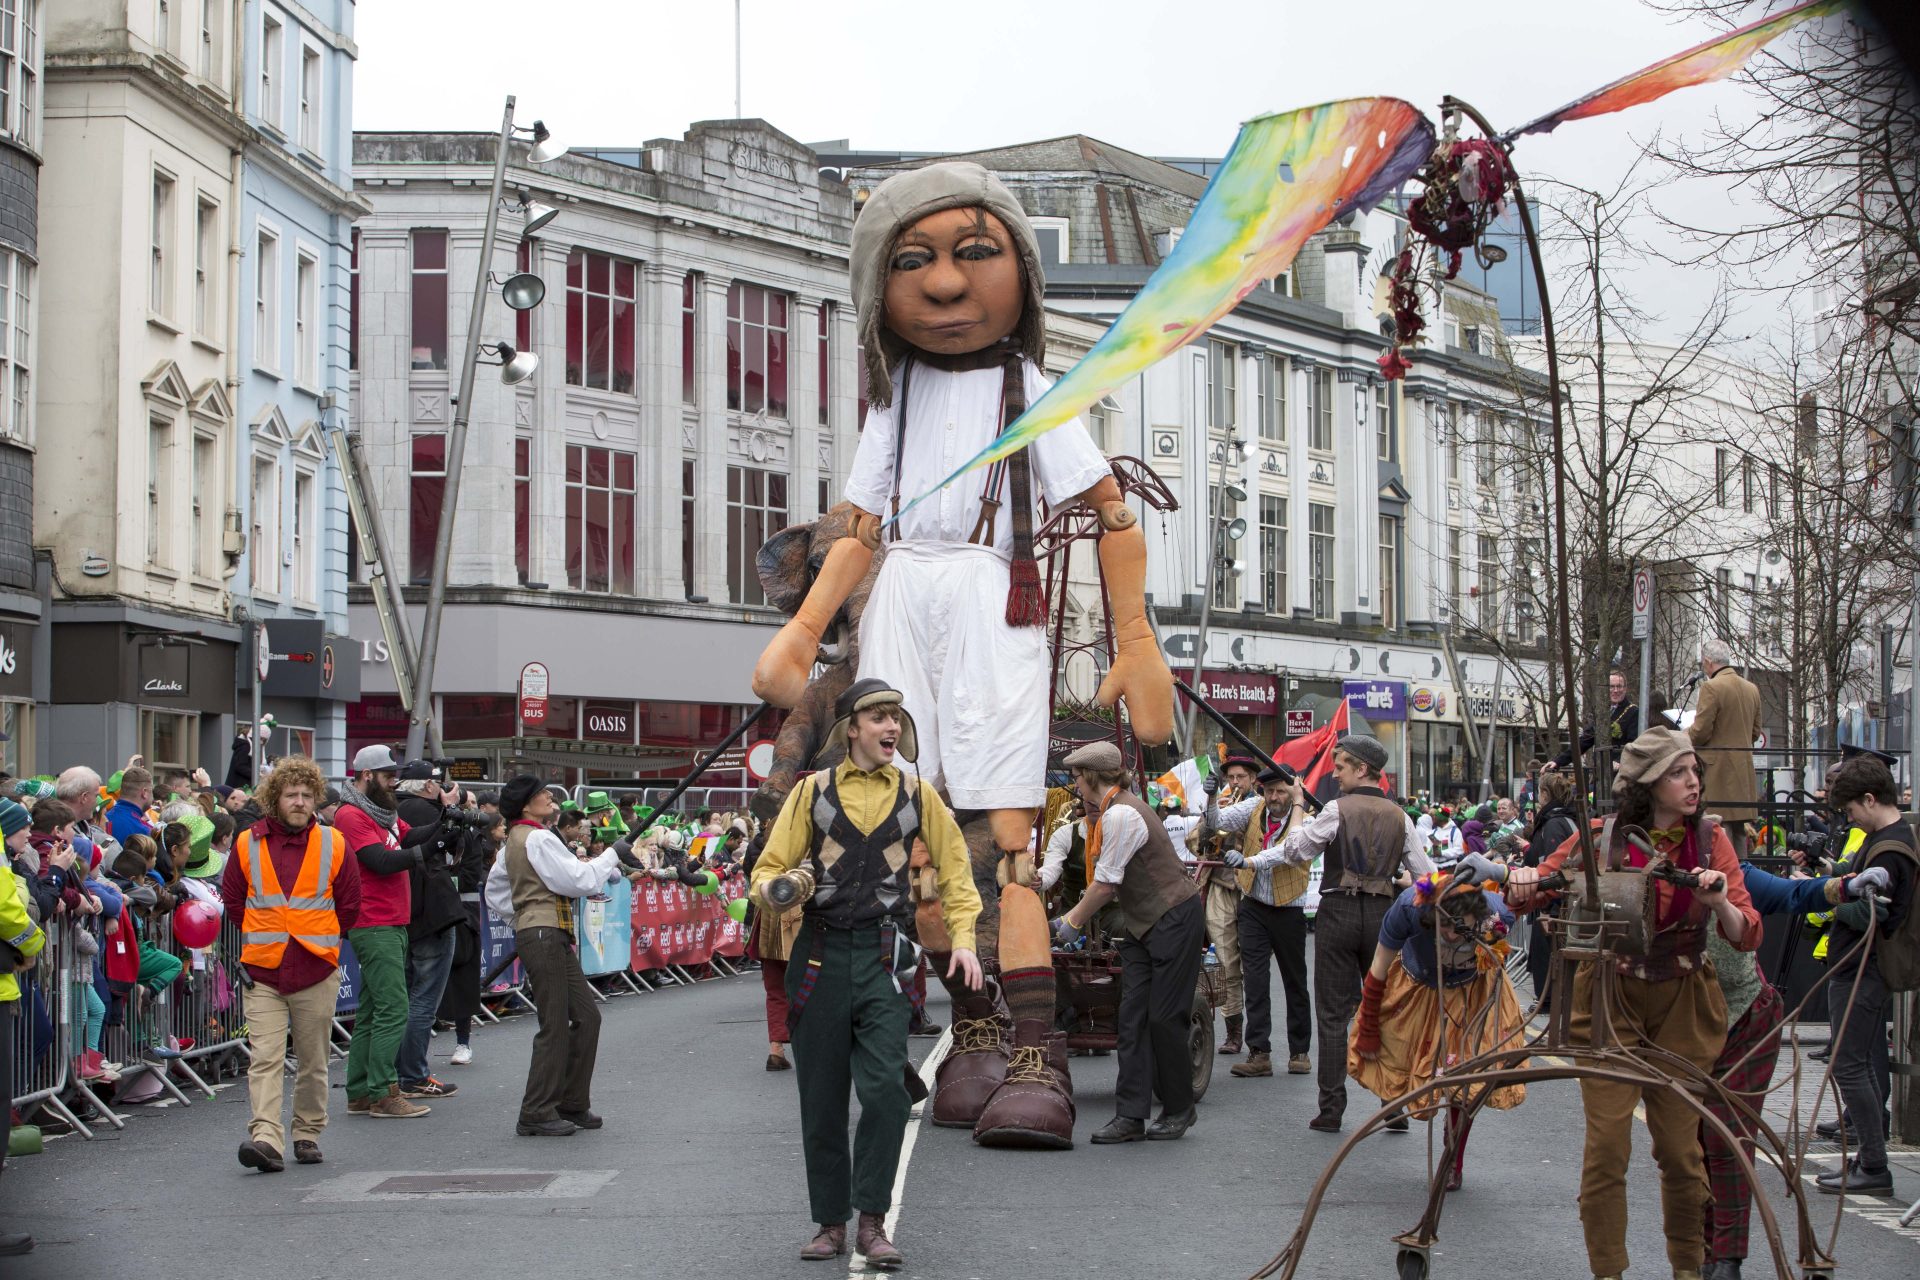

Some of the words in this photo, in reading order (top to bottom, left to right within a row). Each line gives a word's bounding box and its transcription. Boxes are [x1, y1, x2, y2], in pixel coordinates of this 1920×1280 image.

[728, 138, 804, 192] BURTON
[144, 678, 182, 691] Clarks
[1211, 683, 1238, 700] Here's
[1239, 685, 1266, 704] Health
[524, 709, 544, 718] BUS
[1497, 700, 1516, 717] KING
[589, 715, 626, 732] OASIS
[1288, 726, 1311, 734] Health
